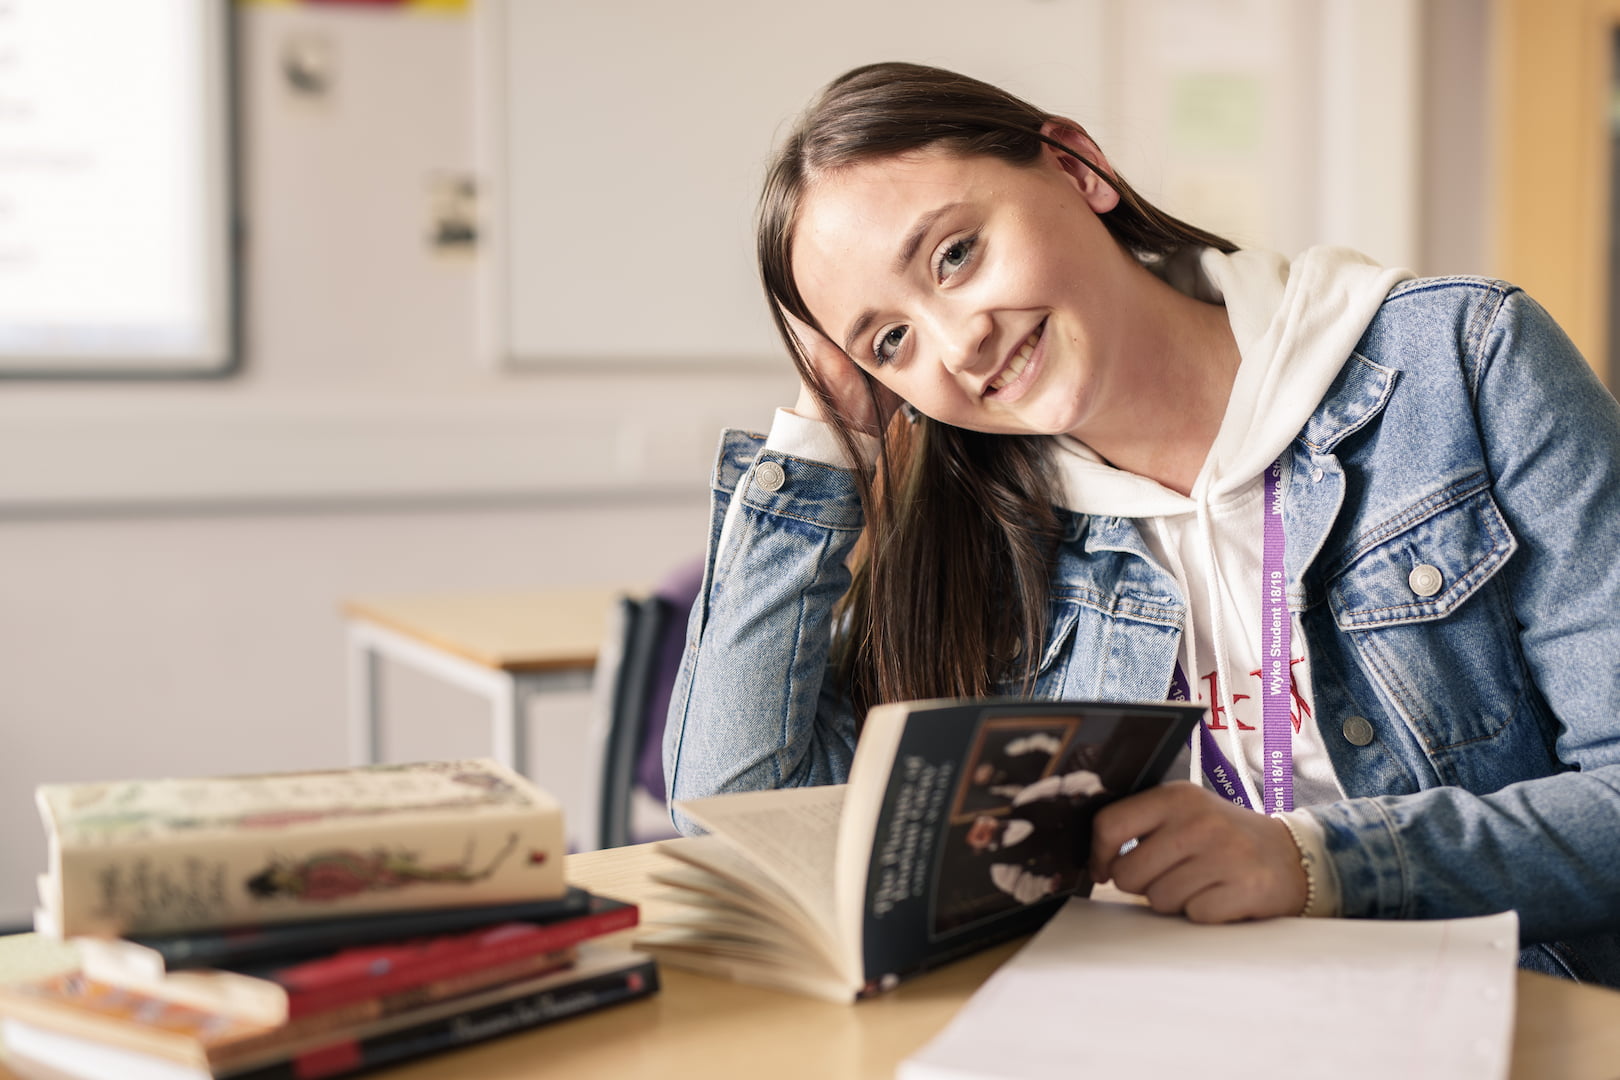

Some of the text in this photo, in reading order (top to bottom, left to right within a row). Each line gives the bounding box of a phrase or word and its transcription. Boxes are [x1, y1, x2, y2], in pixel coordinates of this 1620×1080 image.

[1270, 571, 1284, 696] Wyke Student 18/19
[1213, 765, 1236, 795] Wyke
[1271, 750, 1284, 784] 18/19
